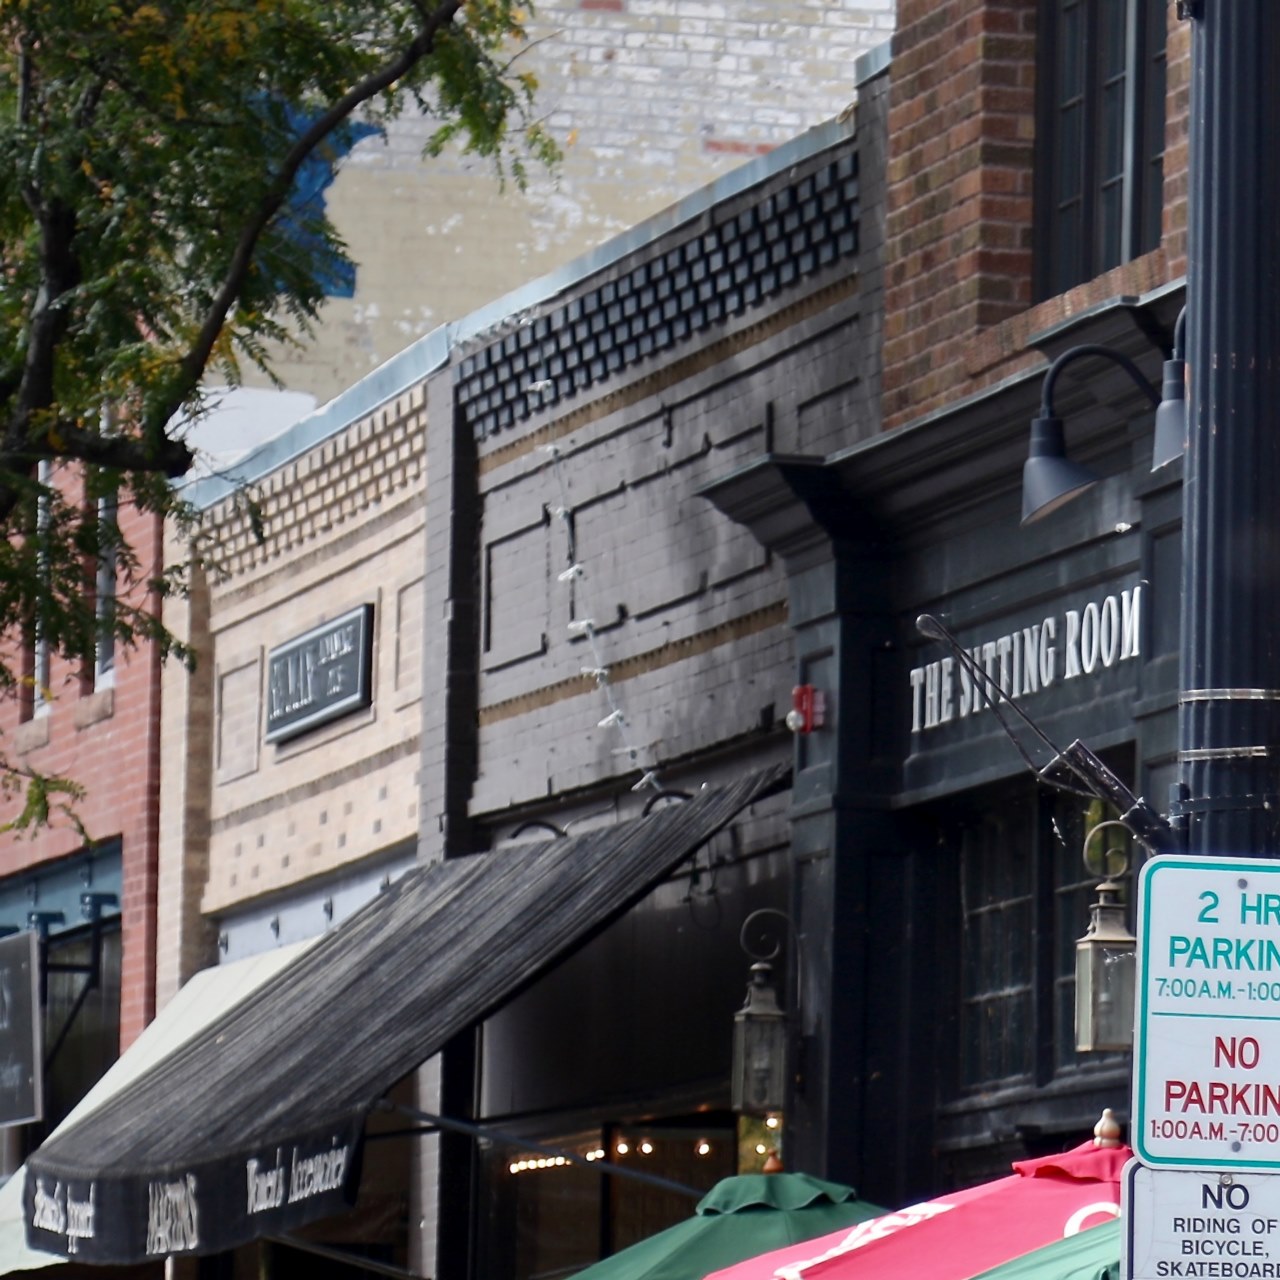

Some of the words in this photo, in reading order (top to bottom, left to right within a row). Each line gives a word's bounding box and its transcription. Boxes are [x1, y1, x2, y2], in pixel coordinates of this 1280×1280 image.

[910, 657, 954, 733] THE
[959, 617, 1056, 717] SITTING
[1197, 891, 1219, 923] 2
[1214, 1036, 1260, 1069] NO
[1201, 1183, 1250, 1210] NO
[1173, 1217, 1240, 1234] RIDING
[1251, 1219, 1278, 1234] OF
[1181, 1240, 1270, 1258] BICYCLE,
